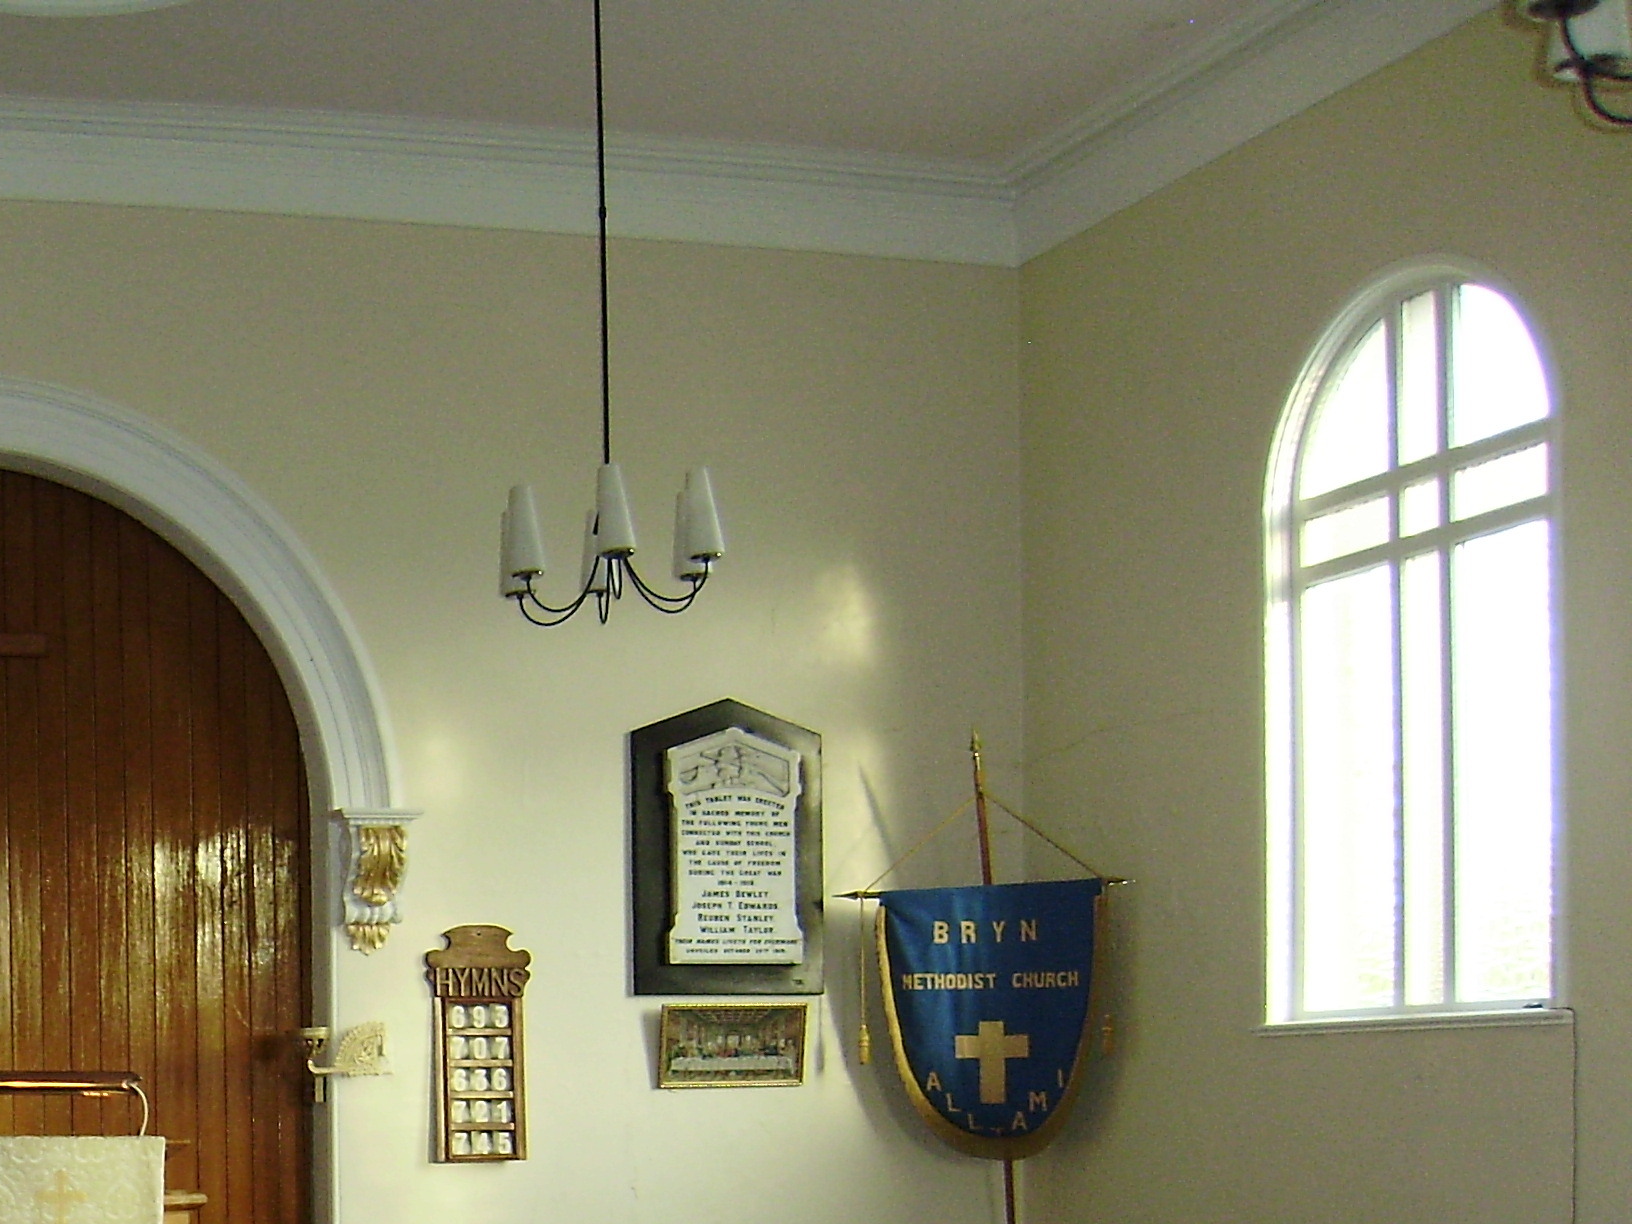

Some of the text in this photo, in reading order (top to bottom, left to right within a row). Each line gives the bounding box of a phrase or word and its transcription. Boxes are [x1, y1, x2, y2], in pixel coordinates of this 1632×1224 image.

[705, 795, 732, 803] TABLET
[692, 901, 722, 909] JOSEPH
[738, 901, 778, 909] EDWARDS
[701, 890, 729, 898] JAMES
[697, 913, 730, 922] REUBEN
[699, 926, 735, 934] WILLIAM
[933, 920, 1037, 943] BRYN
[435, 967, 525, 997] HYMNS
[902, 971, 1079, 991] METHODIST CHURCH
[451, 1005, 509, 1028] 693
[451, 1037, 509, 1059] 707
[452, 1069, 507, 1091] 636
[451, 1101, 508, 1123] 721
[452, 1132, 512, 1154] 745
